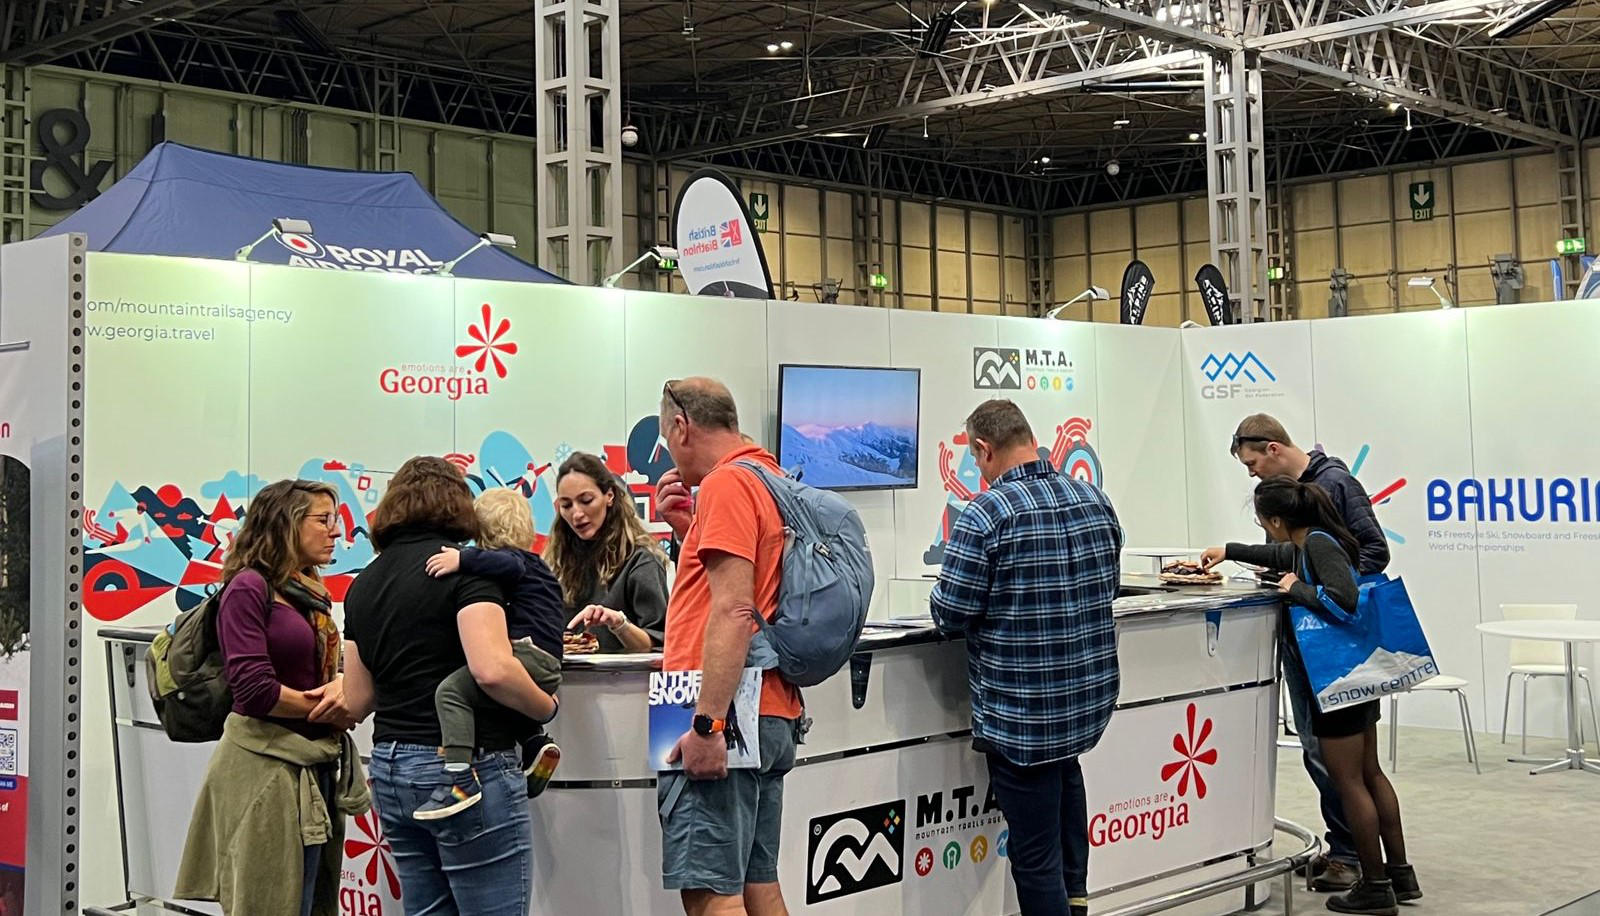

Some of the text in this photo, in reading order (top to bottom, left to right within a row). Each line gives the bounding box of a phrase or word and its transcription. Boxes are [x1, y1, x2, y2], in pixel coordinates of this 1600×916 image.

[1414, 208, 1431, 220] EXIT
[324, 244, 444, 267] ROYAL
[86, 297, 293, 323] om/mountaintrailsagency
[85, 324, 215, 341] w.georgia.travel
[1025, 349, 1073, 367] M.T.A.
[401, 364, 446, 374] emotions
[379, 368, 489, 400] Georgia
[1201, 384, 1242, 400] GSF
[1426, 477, 1600, 522] BAKURI
[1428, 530, 1442, 538] FIS
[1501, 531, 1551, 540] Snowboard
[1554, 532, 1571, 540] and
[1429, 543, 1454, 551] World
[648, 686, 701, 706] SNOW
[916, 779, 1005, 828] M.T.A
[1109, 792, 1168, 814] emotions are
[1088, 795, 1189, 847] Georgia
